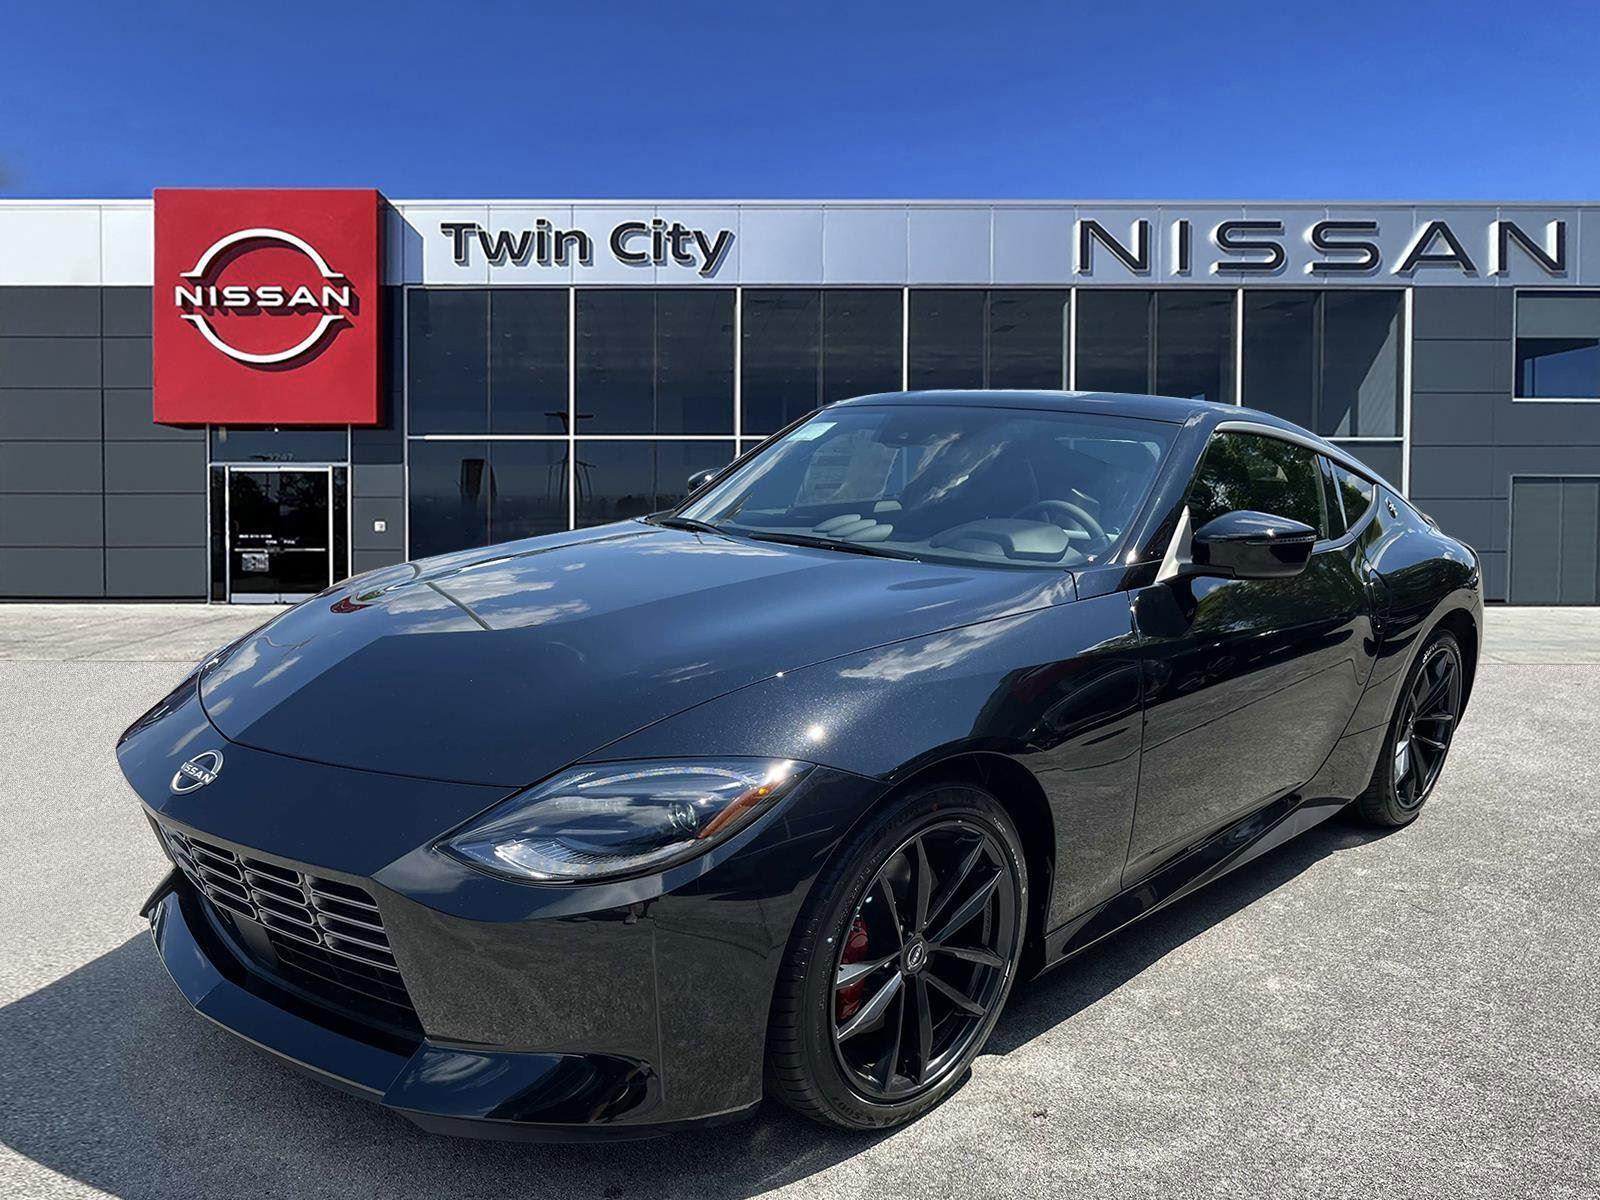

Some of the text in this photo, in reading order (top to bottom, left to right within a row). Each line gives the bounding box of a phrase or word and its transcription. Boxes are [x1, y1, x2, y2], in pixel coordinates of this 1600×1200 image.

[440, 218, 732, 275] Twin City
[1076, 219, 1567, 274] NISSAN
[175, 285, 350, 307] NISSAN
